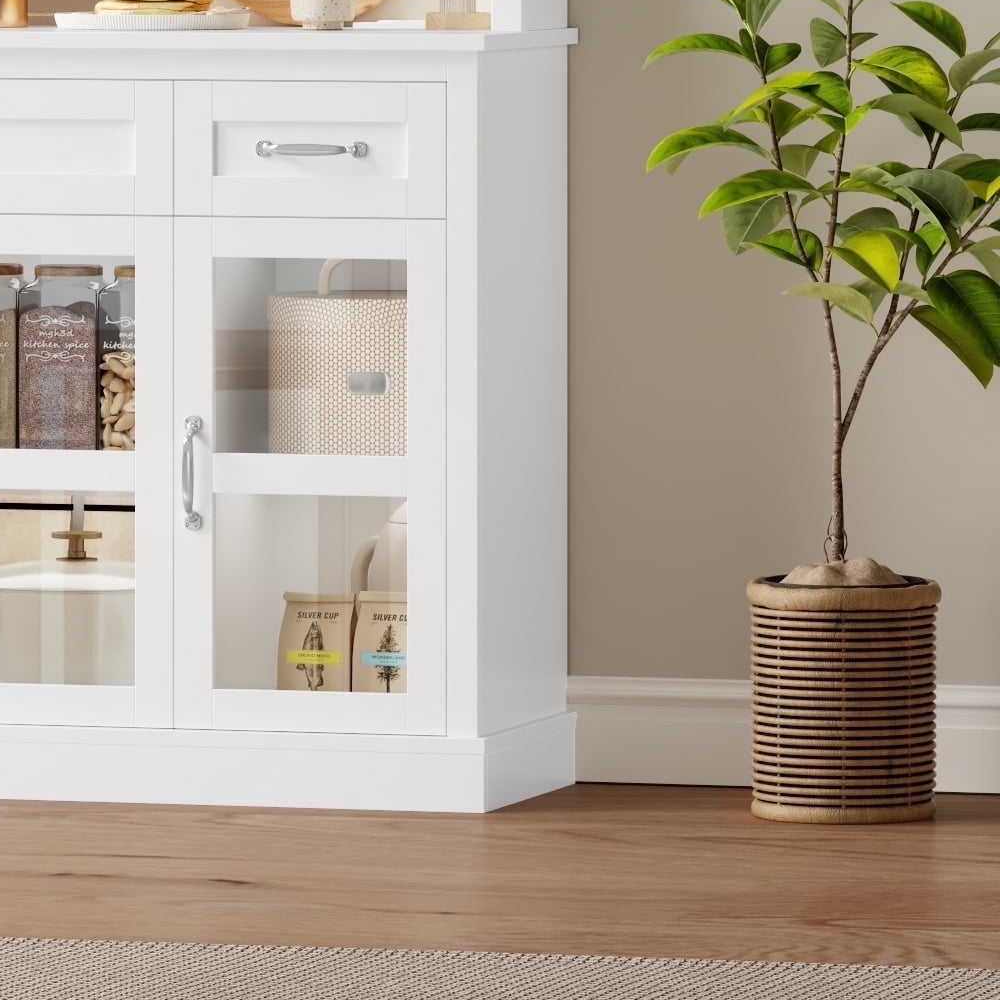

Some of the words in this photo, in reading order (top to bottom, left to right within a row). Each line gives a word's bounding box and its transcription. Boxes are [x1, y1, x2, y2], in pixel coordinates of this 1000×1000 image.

[23, 340, 60, 348] kitchen
[64, 340, 90, 350] spice
[297, 611, 322, 619] SILVER
[323, 611, 340, 620] CUP
[372, 613, 397, 621] SILVER
